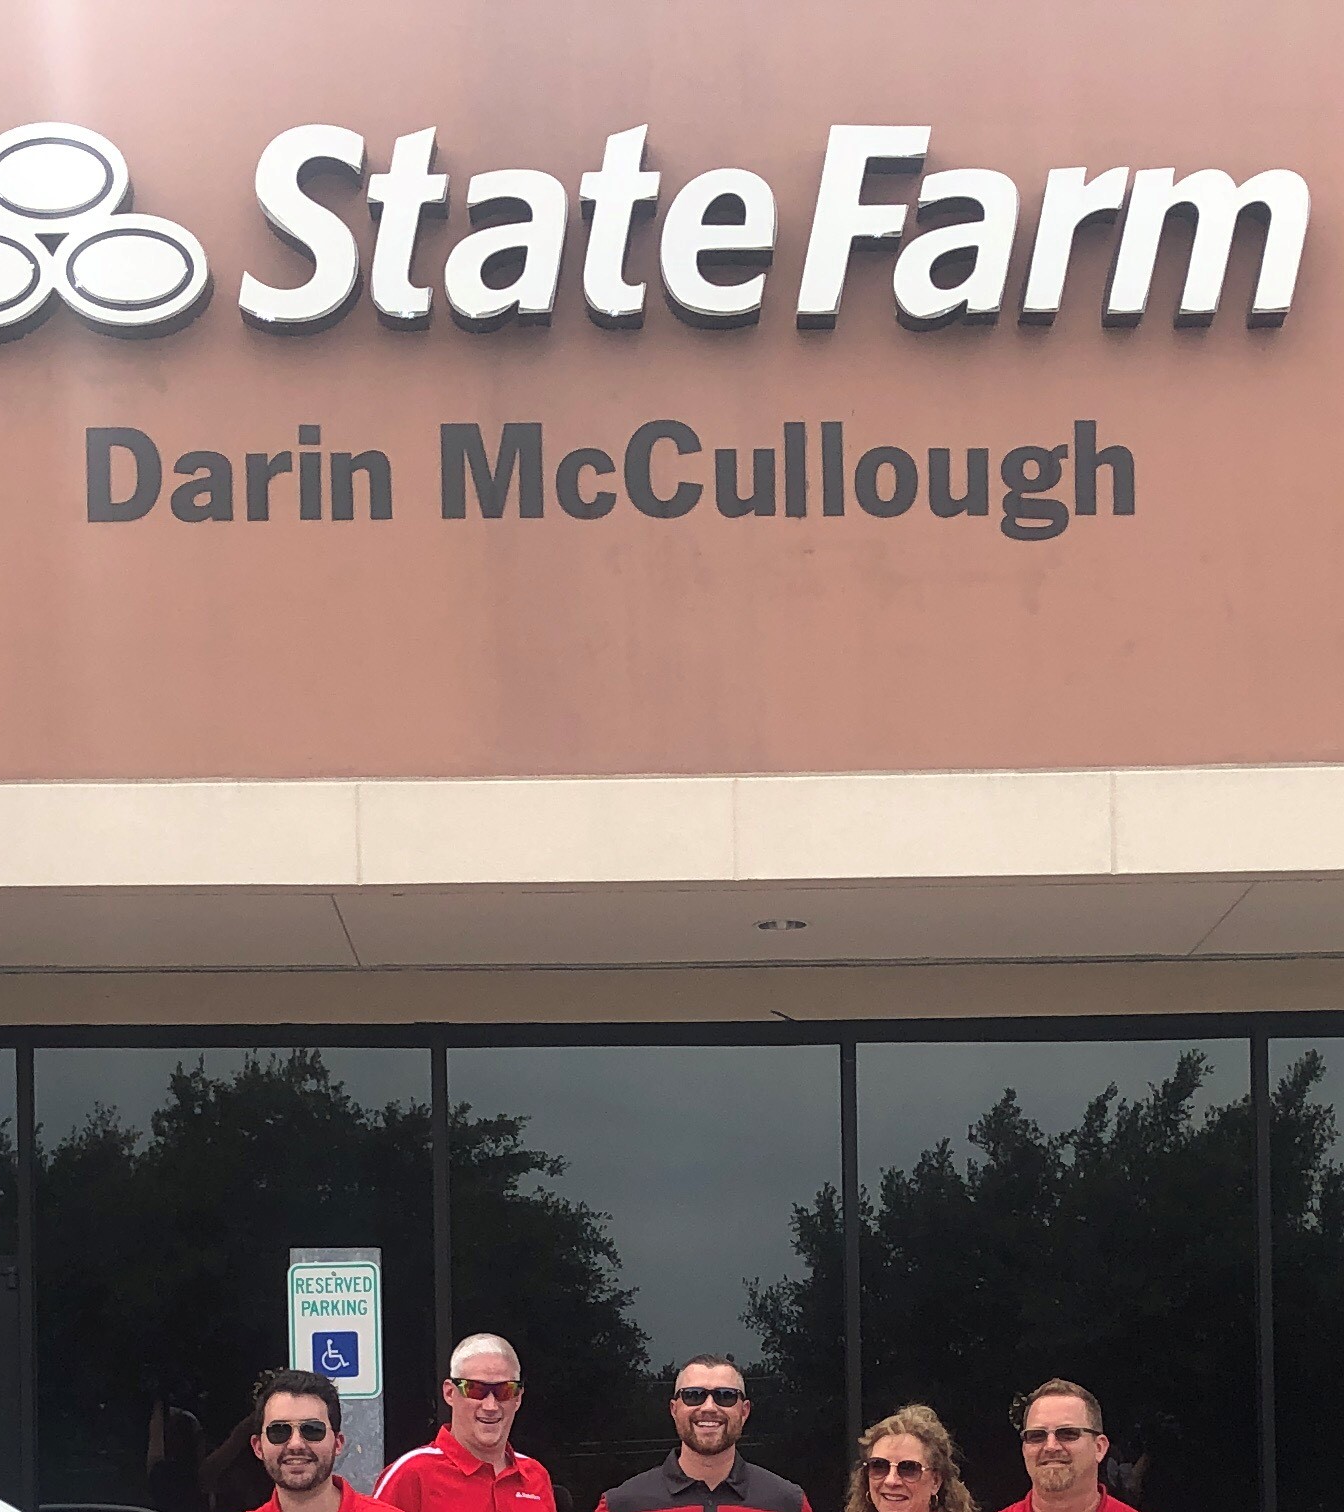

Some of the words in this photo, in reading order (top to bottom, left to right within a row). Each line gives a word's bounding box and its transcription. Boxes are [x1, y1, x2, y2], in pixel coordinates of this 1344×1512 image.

[85, 424, 393, 523] Darin
[439, 418, 1136, 541] McCullough
[296, 1276, 372, 1294] RESERVED
[301, 1299, 368, 1317] PARKING
